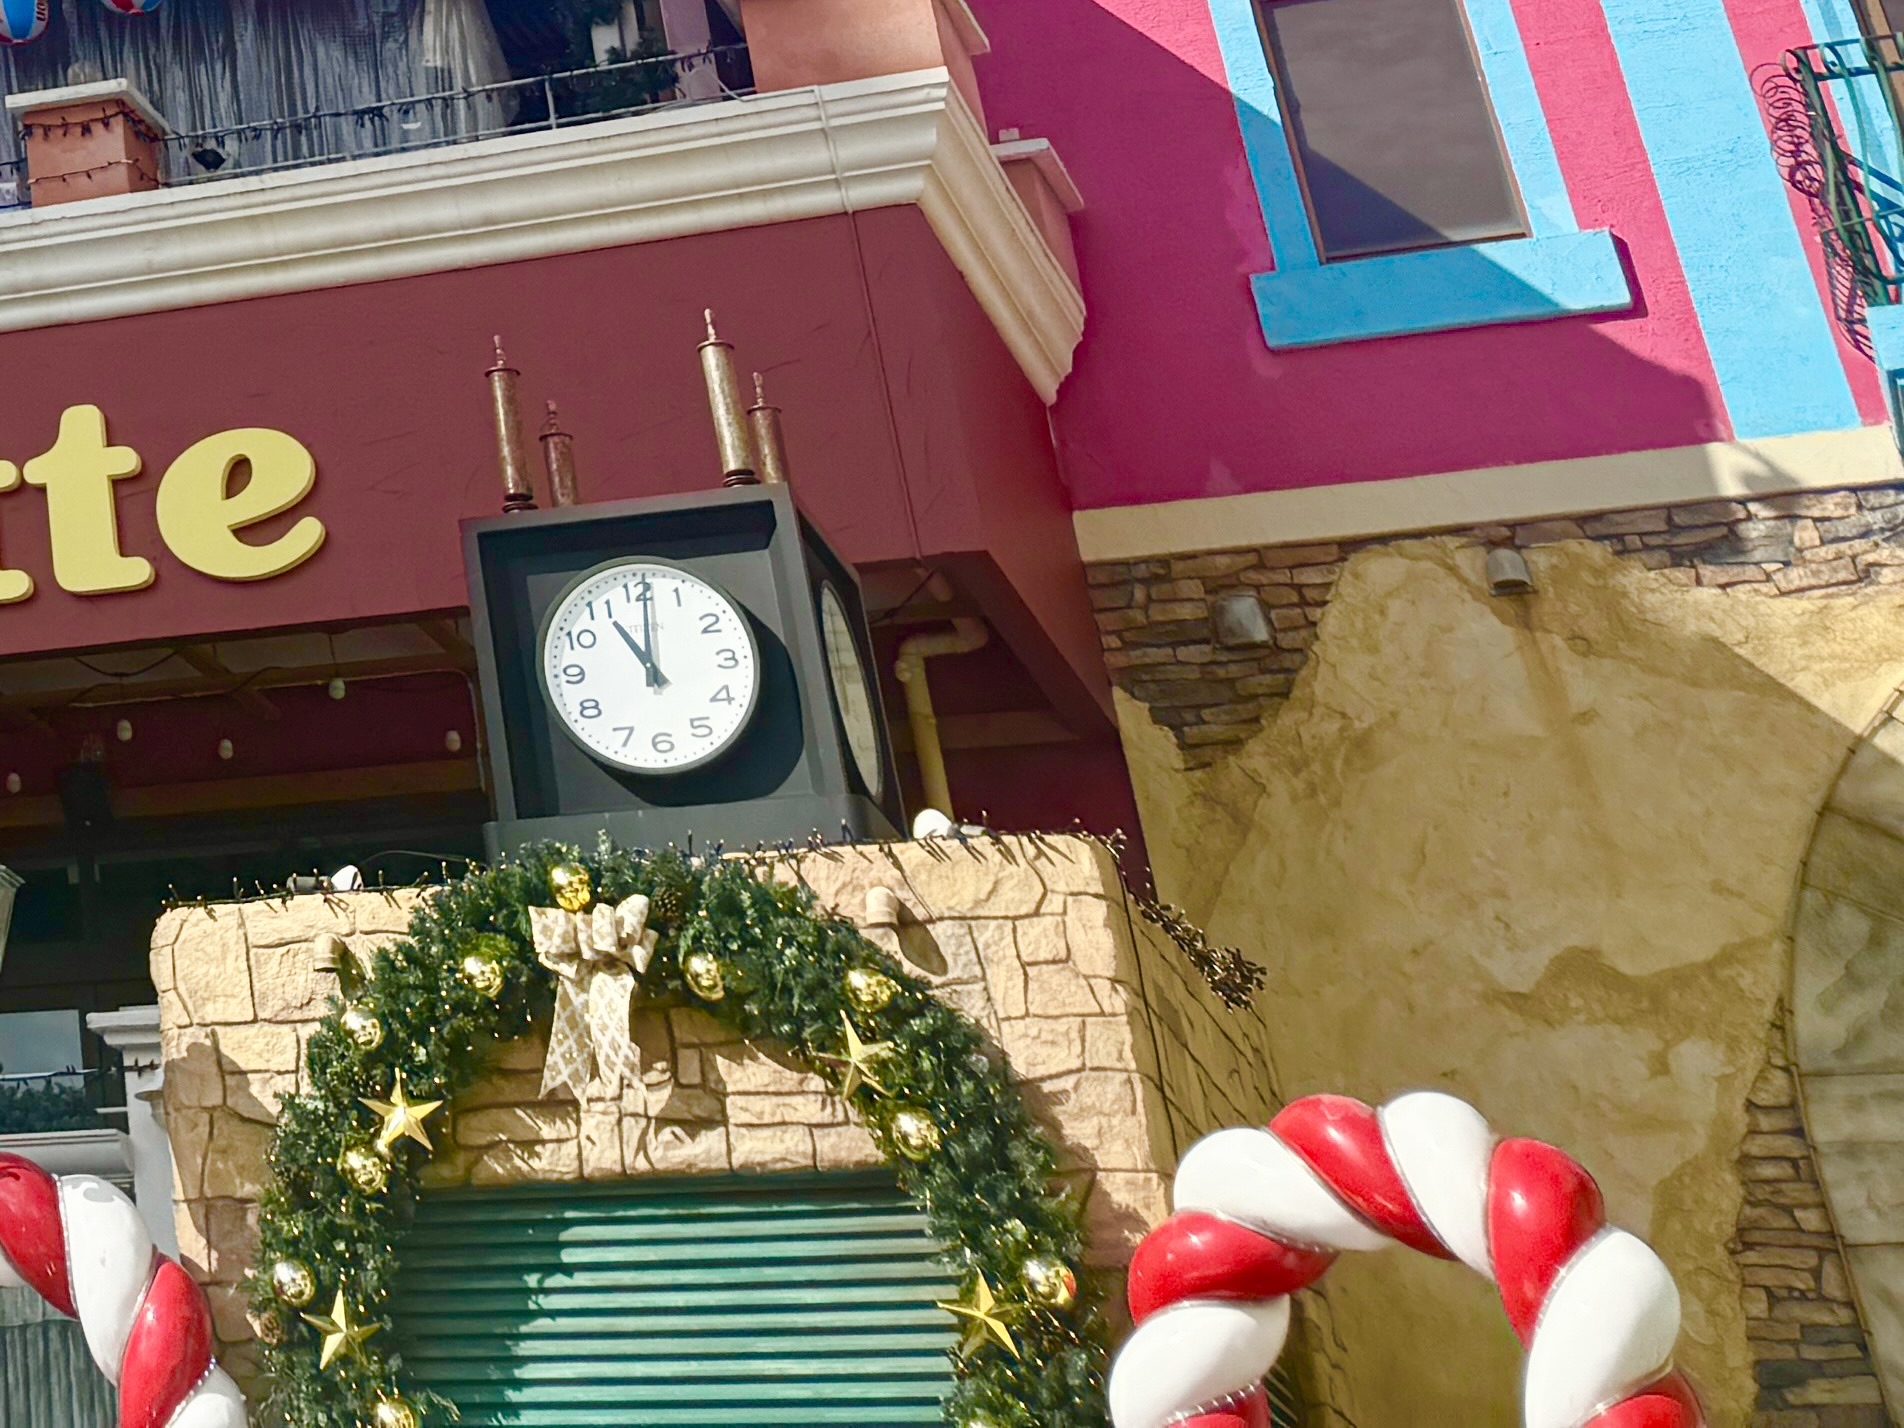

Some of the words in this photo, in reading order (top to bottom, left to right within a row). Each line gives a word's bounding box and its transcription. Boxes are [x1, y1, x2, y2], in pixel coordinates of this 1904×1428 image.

[622, 581, 652, 603] 12
[585, 598, 615, 621] 11
[698, 612, 723, 634] 2
[565, 628, 597, 651] 10
[715, 648, 740, 669] 3
[563, 663, 586, 685] 9
[709, 684, 736, 706] 4
[579, 698, 603, 719] 8
[612, 725, 635, 748] 7
[689, 716, 714, 739] 5
[651, 732, 675, 753] 6
